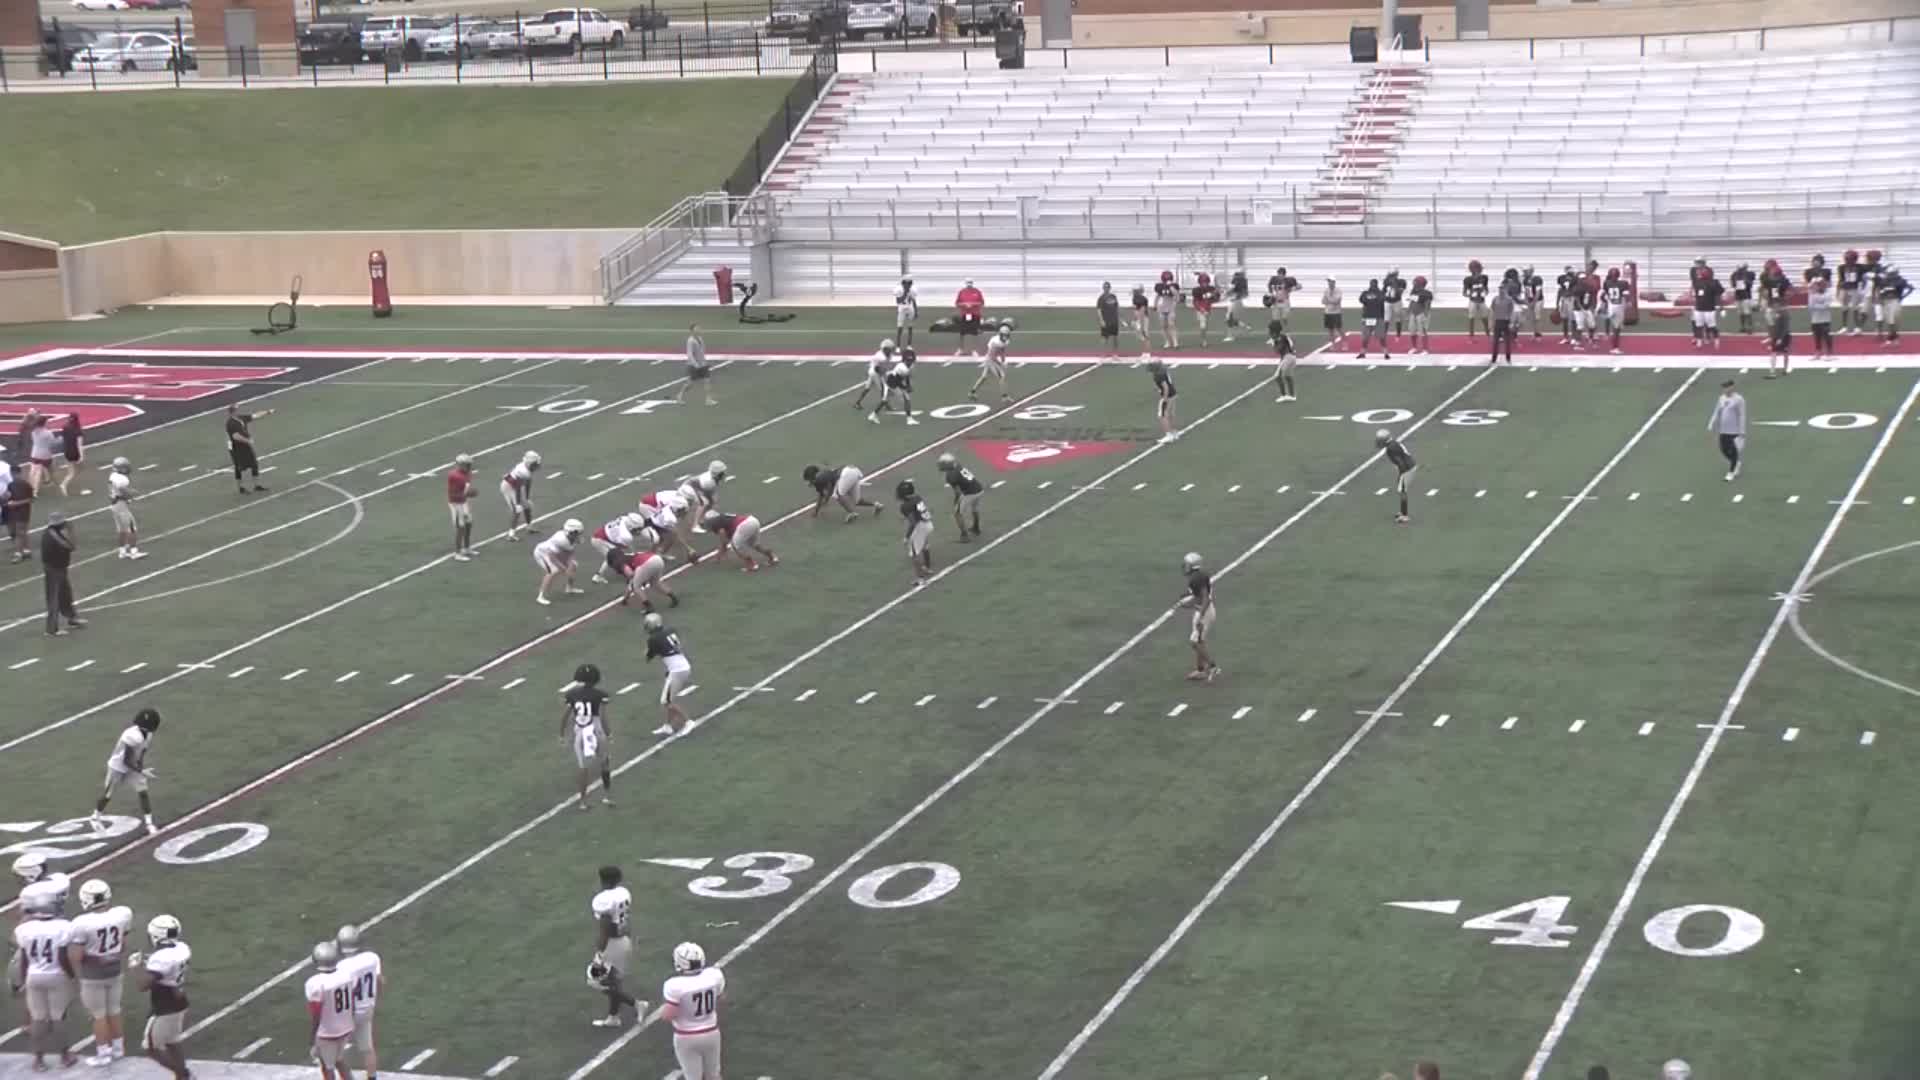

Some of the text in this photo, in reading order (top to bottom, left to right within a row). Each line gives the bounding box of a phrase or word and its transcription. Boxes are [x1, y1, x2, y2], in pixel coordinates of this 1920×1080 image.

[30, 938, 53, 963] 44
[96, 926, 120, 953] 73
[334, 985, 350, 1013] 81
[692, 989, 715, 1017] 70
